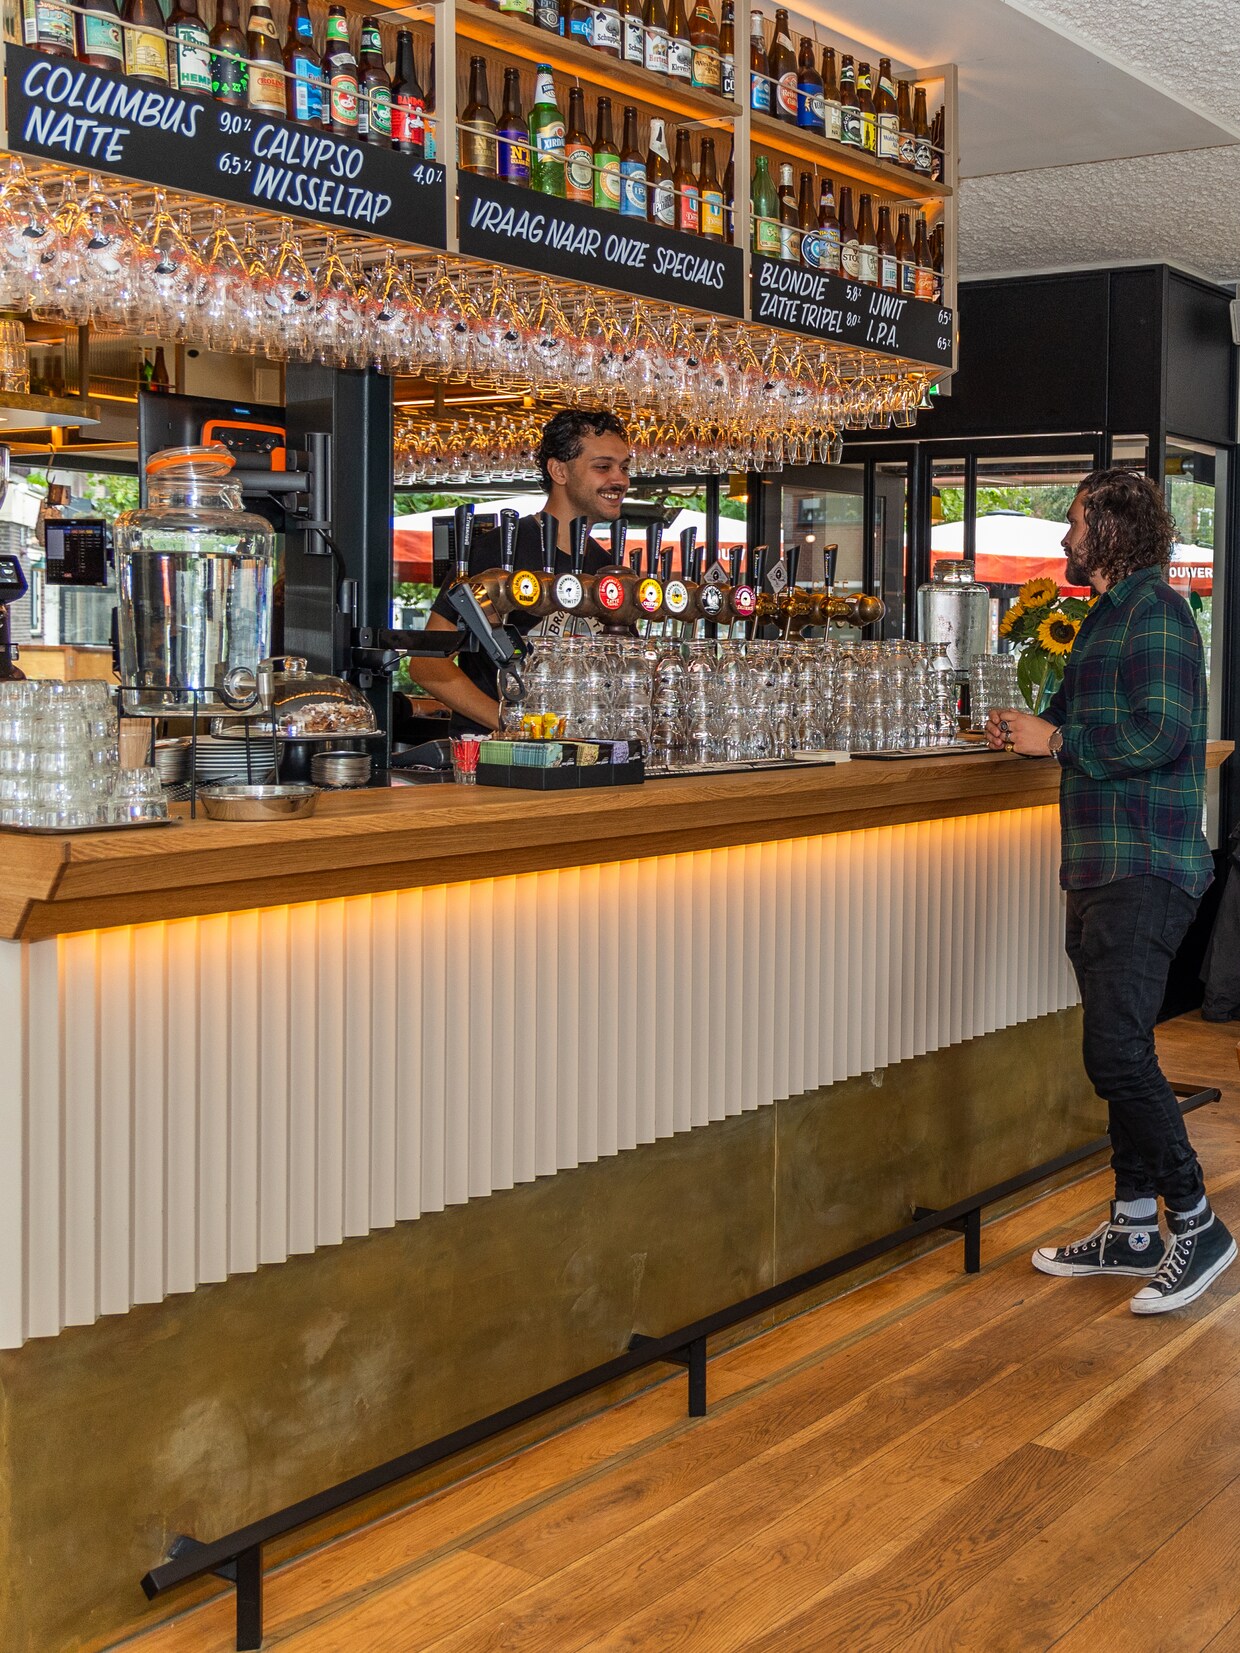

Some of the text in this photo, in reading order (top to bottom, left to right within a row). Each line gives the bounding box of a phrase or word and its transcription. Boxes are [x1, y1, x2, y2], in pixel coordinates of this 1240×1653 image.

[24, 62, 205, 137] COLUMBUS
[24, 105, 131, 162] NATTE
[254, 124, 364, 179] CALYPSO
[253, 163, 392, 224] WISSELTAP
[470, 197, 725, 289] VRAAG NAAR ONZE SPECIALS
[759, 262, 829, 300] BLONDIE
[869, 292, 907, 321] IJWIT
[759, 292, 800, 323] ZATTE
[800, 303, 843, 333] TRIPEL
